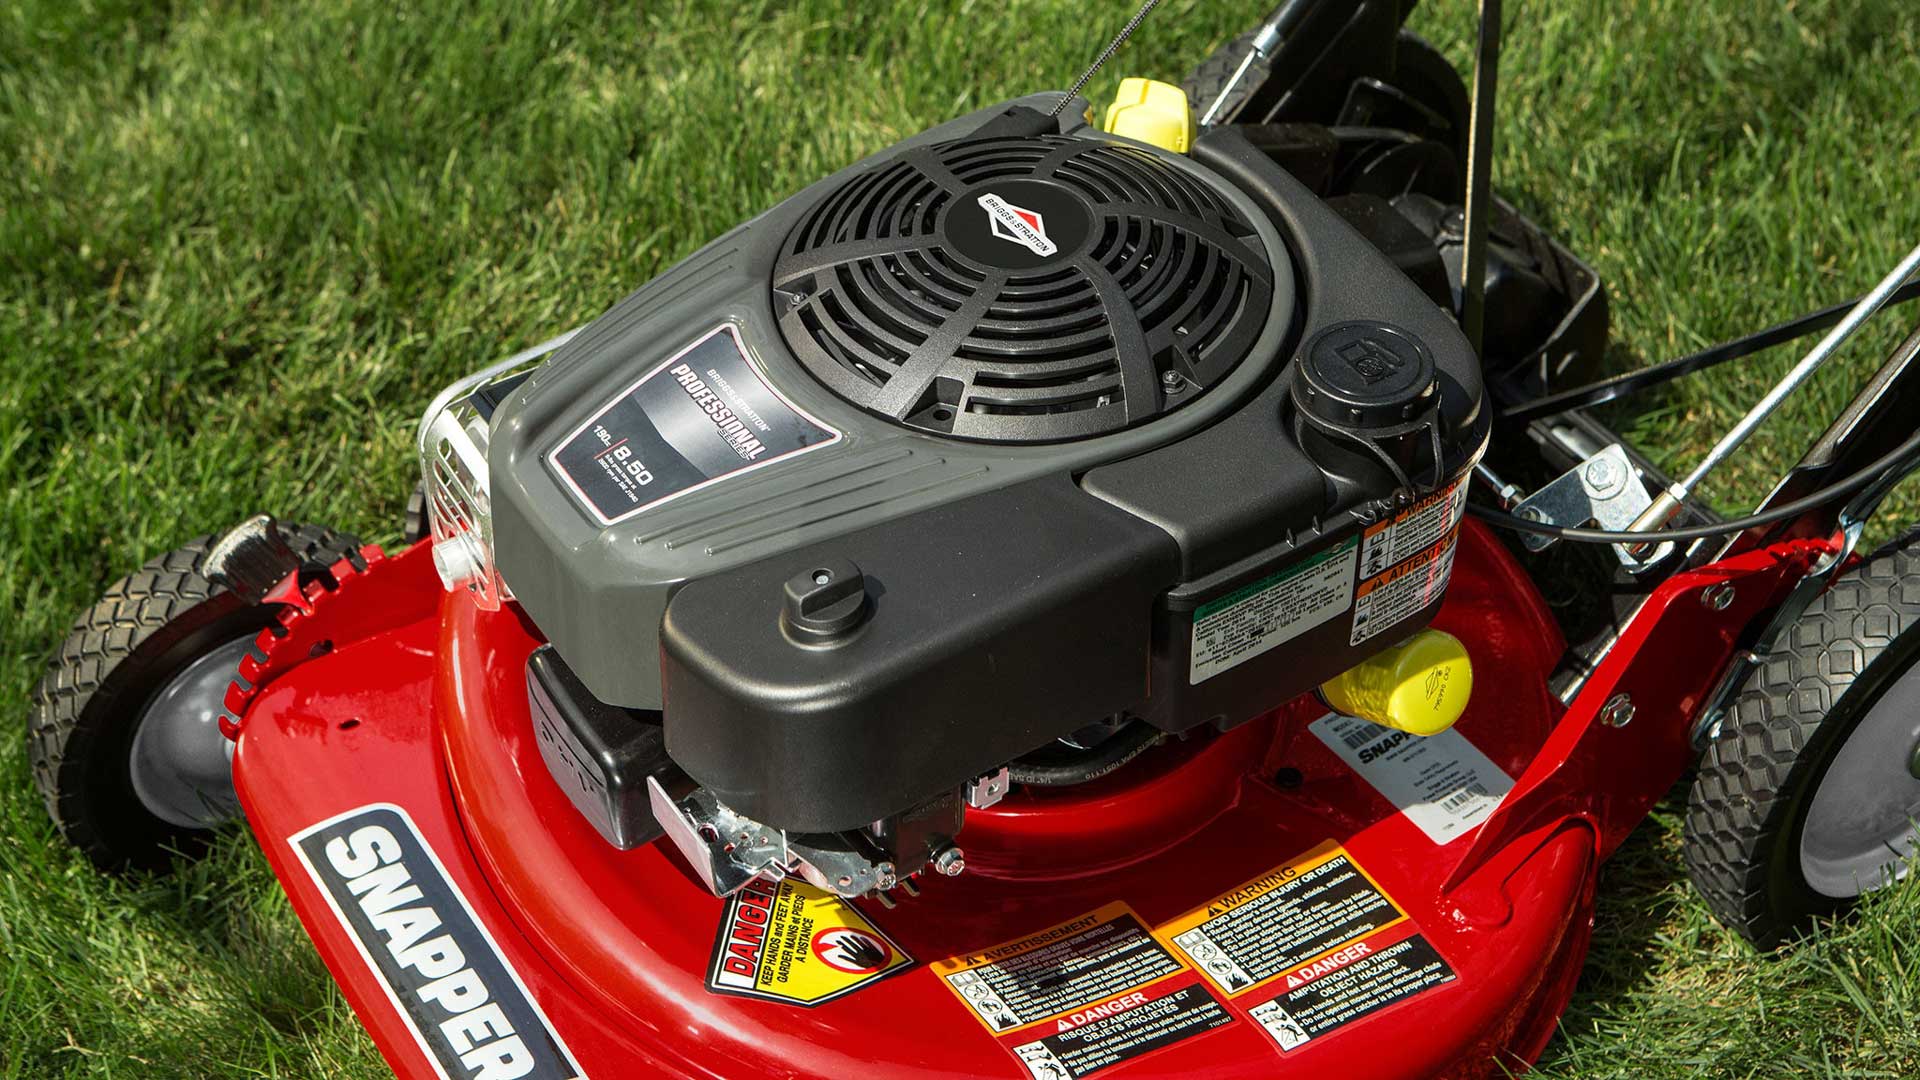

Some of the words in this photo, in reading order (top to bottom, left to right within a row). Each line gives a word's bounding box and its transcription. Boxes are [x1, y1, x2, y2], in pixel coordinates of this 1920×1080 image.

[670, 363, 767, 460] PROFESSIONAL
[613, 445, 654, 486] 8.50
[781, 882, 793, 903] AWAY
[792, 894, 806, 916] PIEDS
[1202, 914, 1229, 931] AVOID
[1229, 895, 1269, 917] SERIOUS
[1268, 878, 1300, 898] INJURY
[1301, 871, 1316, 882] OR
[1315, 856, 1346, 875] DEATH
[1219, 865, 1296, 909] WARNING
[724, 877, 777, 978] DANGER
[774, 922, 785, 937] and
[776, 902, 788, 922] FEET
[325, 825, 535, 1080] SNAPPER
[766, 938, 780, 965] HANDS
[784, 924, 798, 950] MAINS
[797, 918, 813, 955] DISTANCE
[984, 916, 1098, 961] AVERTISSEMENT
[760, 967, 774, 986] KEEP
[777, 950, 793, 982] GARDER
[1289, 969, 1348, 1000] AMPUTATION
[1349, 960, 1369, 973] AND
[1368, 941, 1411, 962] THROWN
[1299, 942, 1370, 979] DANGER
[1320, 976, 1357, 996] OBJECT
[1358, 958, 1397, 979] HAZARD
[1071, 992, 1147, 1024] DANGER
[1295, 1007, 1314, 1018] Keep
[1312, 998, 1334, 1010] hands
[1334, 991, 1347, 1001] and
[1345, 986, 1360, 996] feet
[1360, 979, 1377, 990] away
[1375, 972, 1392, 982] from
[1392, 965, 1410, 975] deck.
[1313, 1011, 1326, 1020] not
[1325, 1001, 1349, 1015] operate
[1349, 992, 1371, 1004] mower
[1371, 982, 1393, 994] unless
[1392, 969, 1423, 985] discharge
[1423, 962, 1441, 972] chute
[1058, 1024, 1098, 1041] RISQUE
[1098, 996, 1174, 1027] D'AMPUTATION
[1174, 990, 1188, 999] ET
[1083, 1023, 1124, 1041] OBJETS
[1122, 1004, 1178, 1026] PROJETÉS
